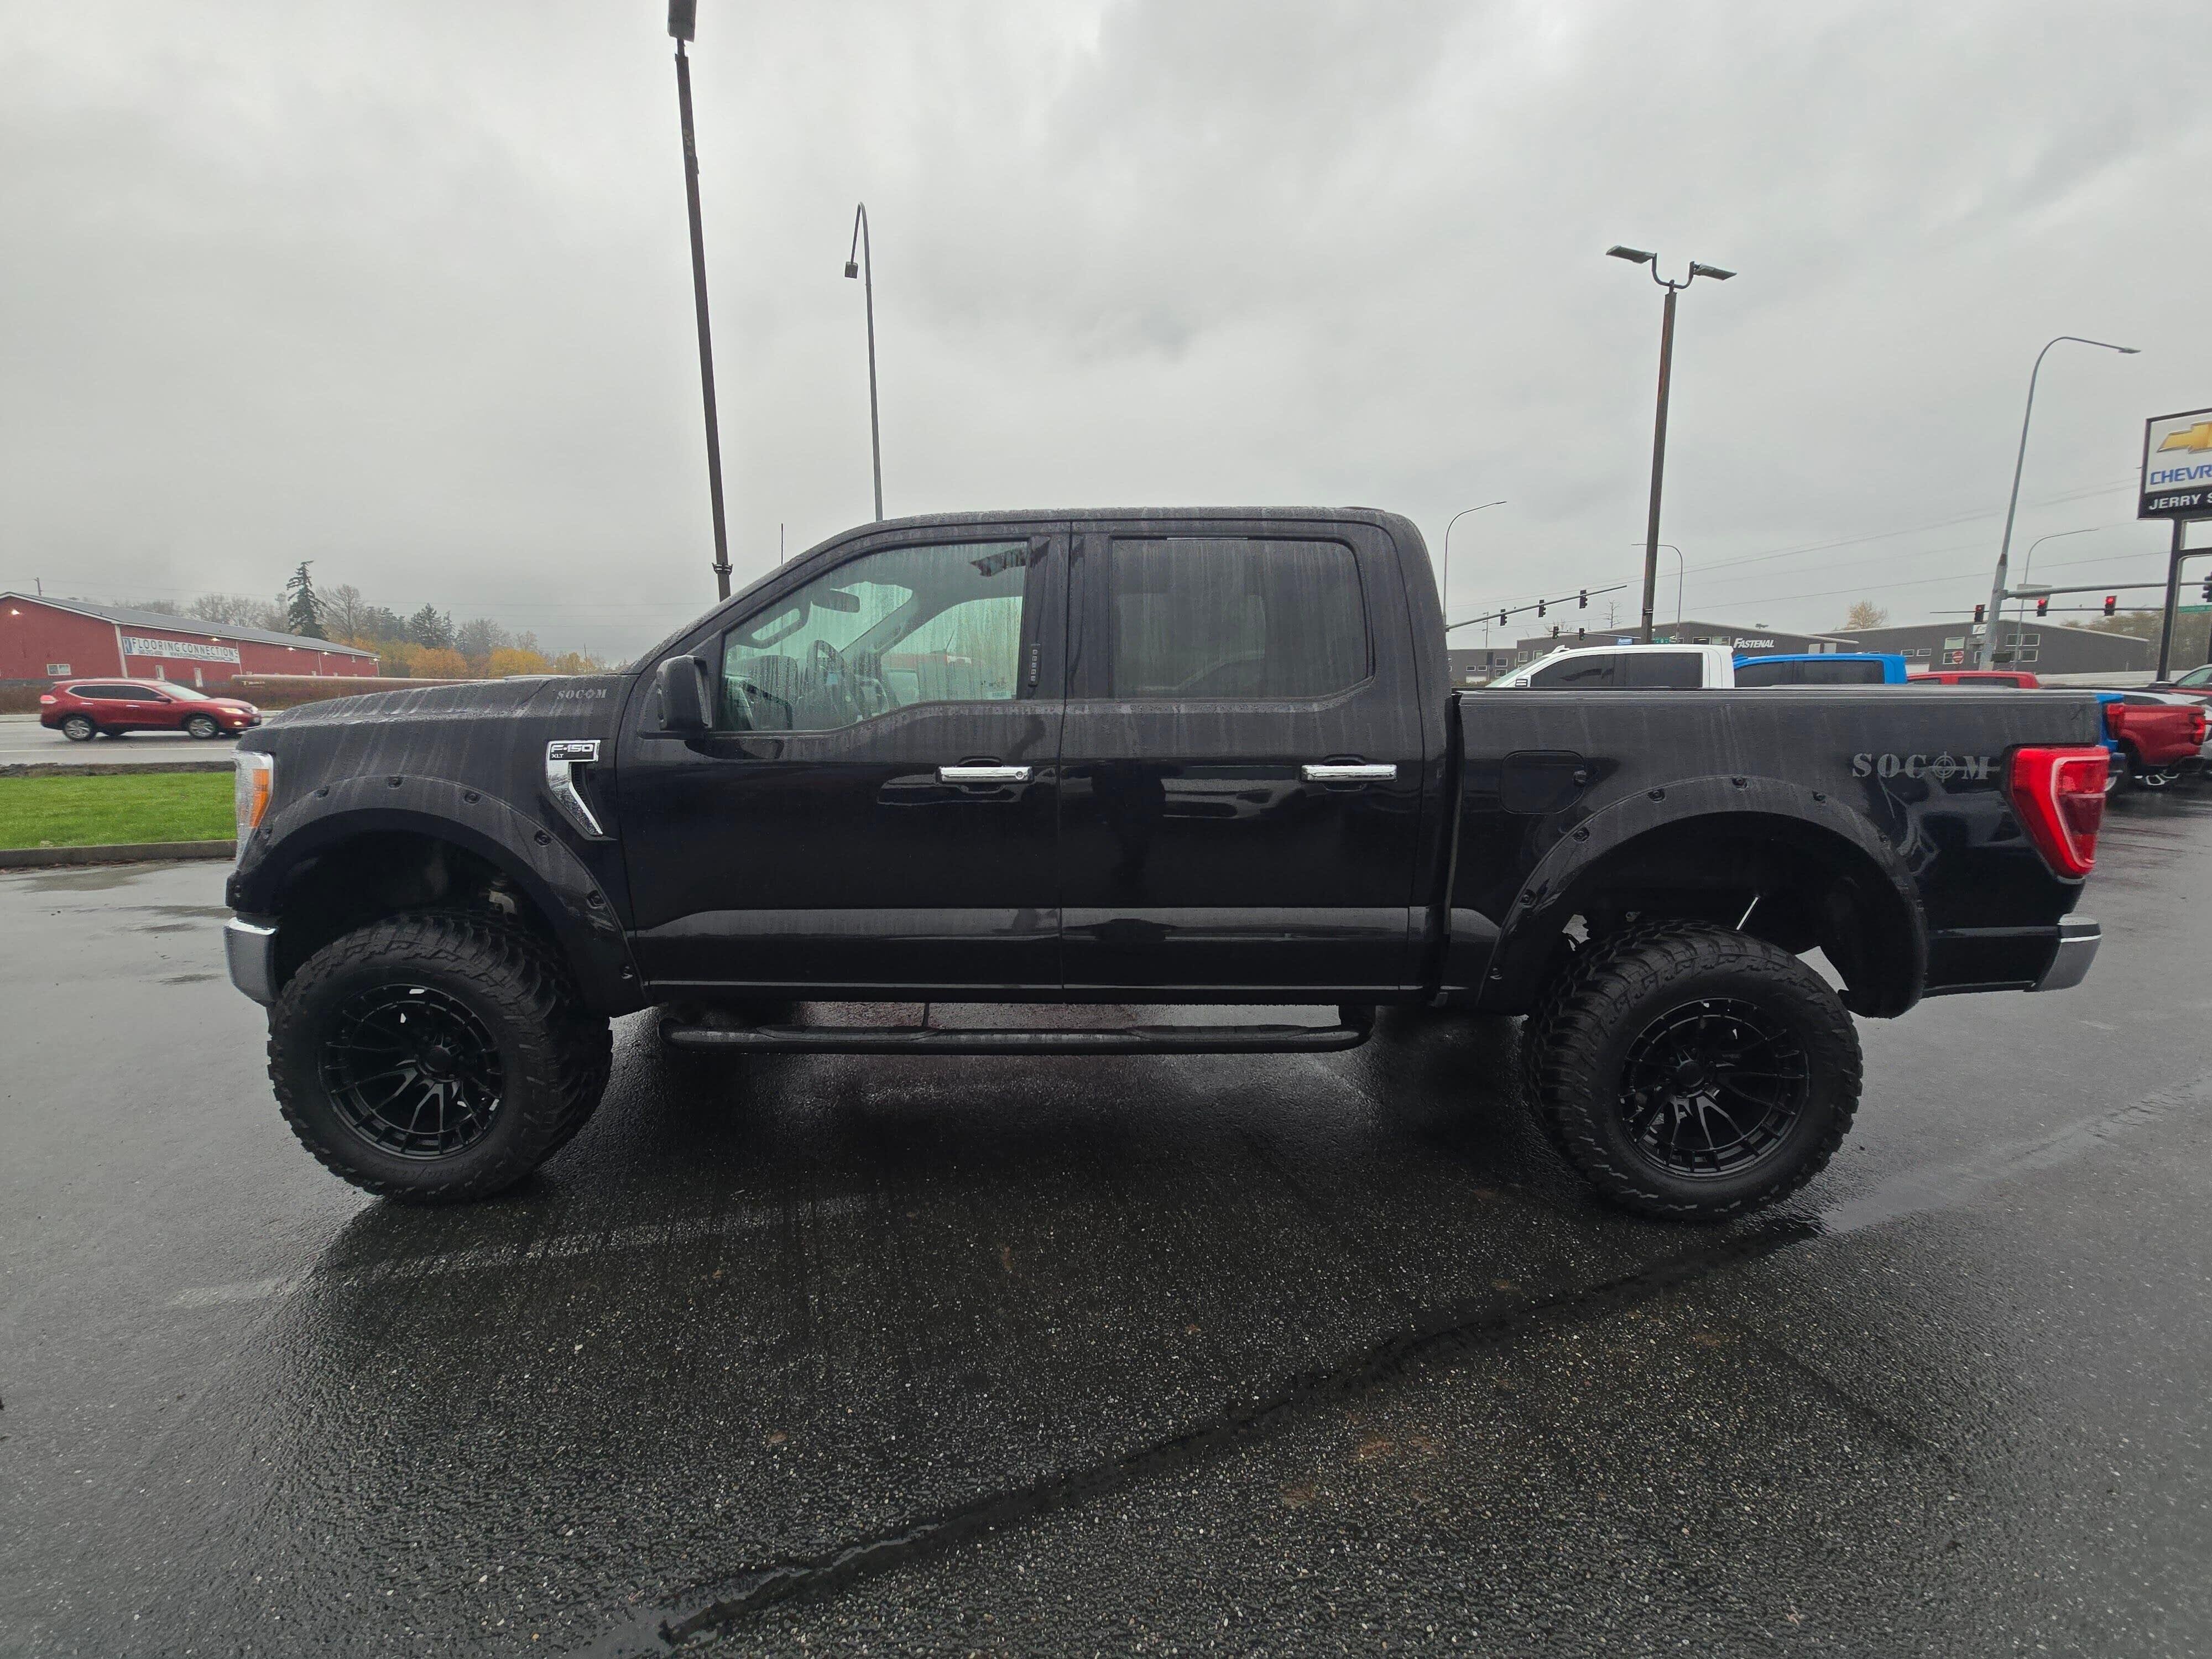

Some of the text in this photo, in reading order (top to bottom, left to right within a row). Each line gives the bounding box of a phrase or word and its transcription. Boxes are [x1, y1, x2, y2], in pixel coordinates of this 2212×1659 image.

[2148, 494, 2201, 510] JERRY
[1733, 638, 1775, 649] FASTENAL
[551, 744, 594, 753] F-150
